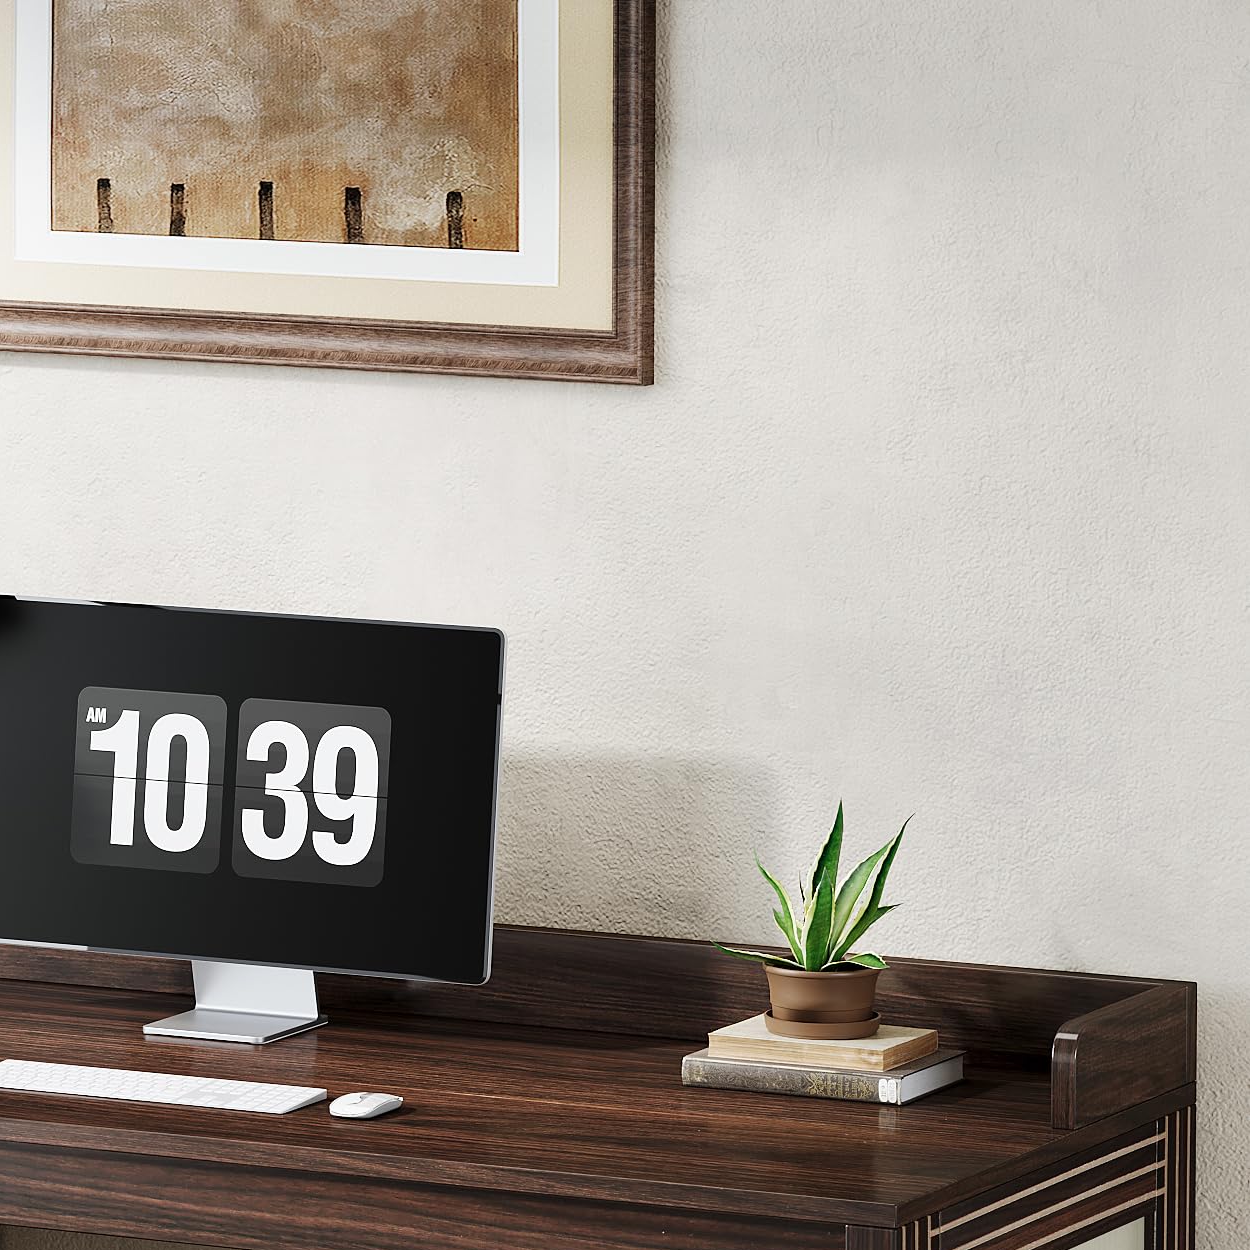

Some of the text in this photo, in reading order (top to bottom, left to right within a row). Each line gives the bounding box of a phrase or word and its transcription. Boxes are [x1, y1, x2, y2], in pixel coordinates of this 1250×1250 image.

[85, 706, 107, 724] AM
[90, 709, 379, 866] 10 39
